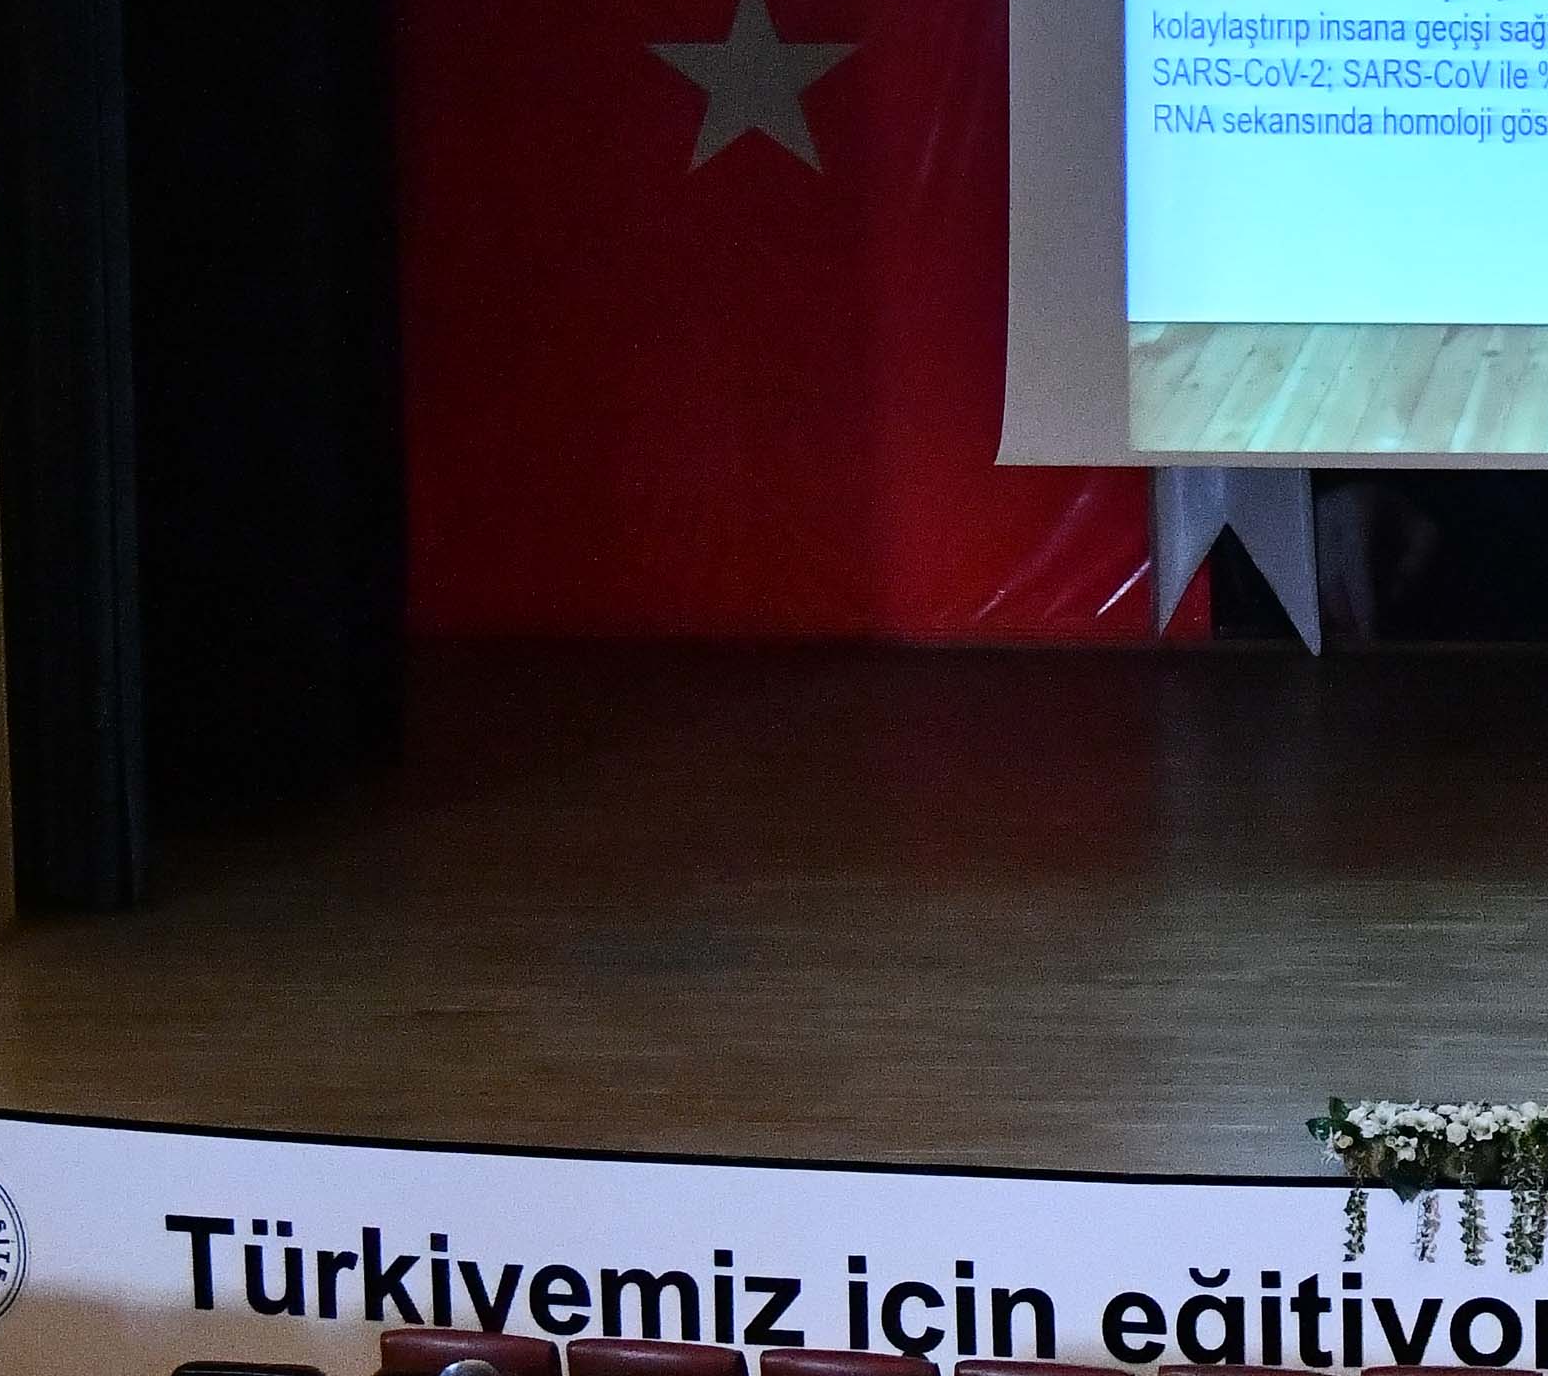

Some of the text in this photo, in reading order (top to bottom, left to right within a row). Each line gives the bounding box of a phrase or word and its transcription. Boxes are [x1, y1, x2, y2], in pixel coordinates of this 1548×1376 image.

[1152, 12, 1309, 47] kolaylaştırıp
[1319, 14, 1406, 43] insana
[1415, 14, 1490, 51] geçişi
[1344, 59, 1489, 89] SARS-CoV
[1499, 61, 1528, 89] ile
[1153, 104, 1213, 132] RNA
[1223, 104, 1373, 134] sekansında
[1383, 106, 1492, 143] homoloji
[165, 1214, 805, 1348] Türkiyemiz
[848, 1255, 1056, 1360] için
